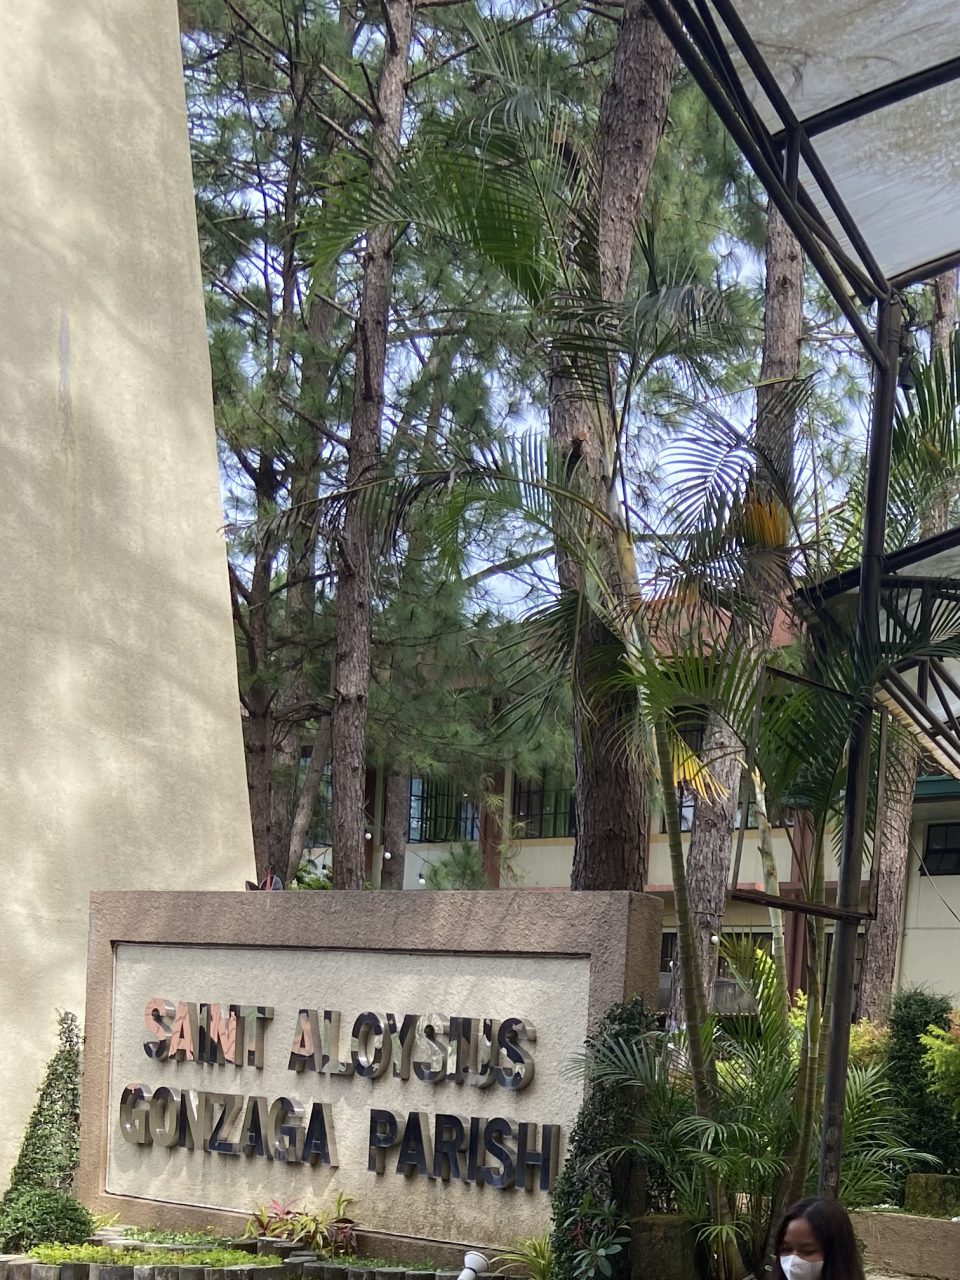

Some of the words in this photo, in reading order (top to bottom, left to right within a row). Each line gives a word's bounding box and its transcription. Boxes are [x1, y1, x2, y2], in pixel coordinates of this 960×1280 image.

[143, 997, 275, 1069] SAINT
[287, 1008, 537, 1091] ALOYSIUS
[119, 1082, 339, 1169] GONZAGA
[367, 1107, 561, 1194] PARISH
